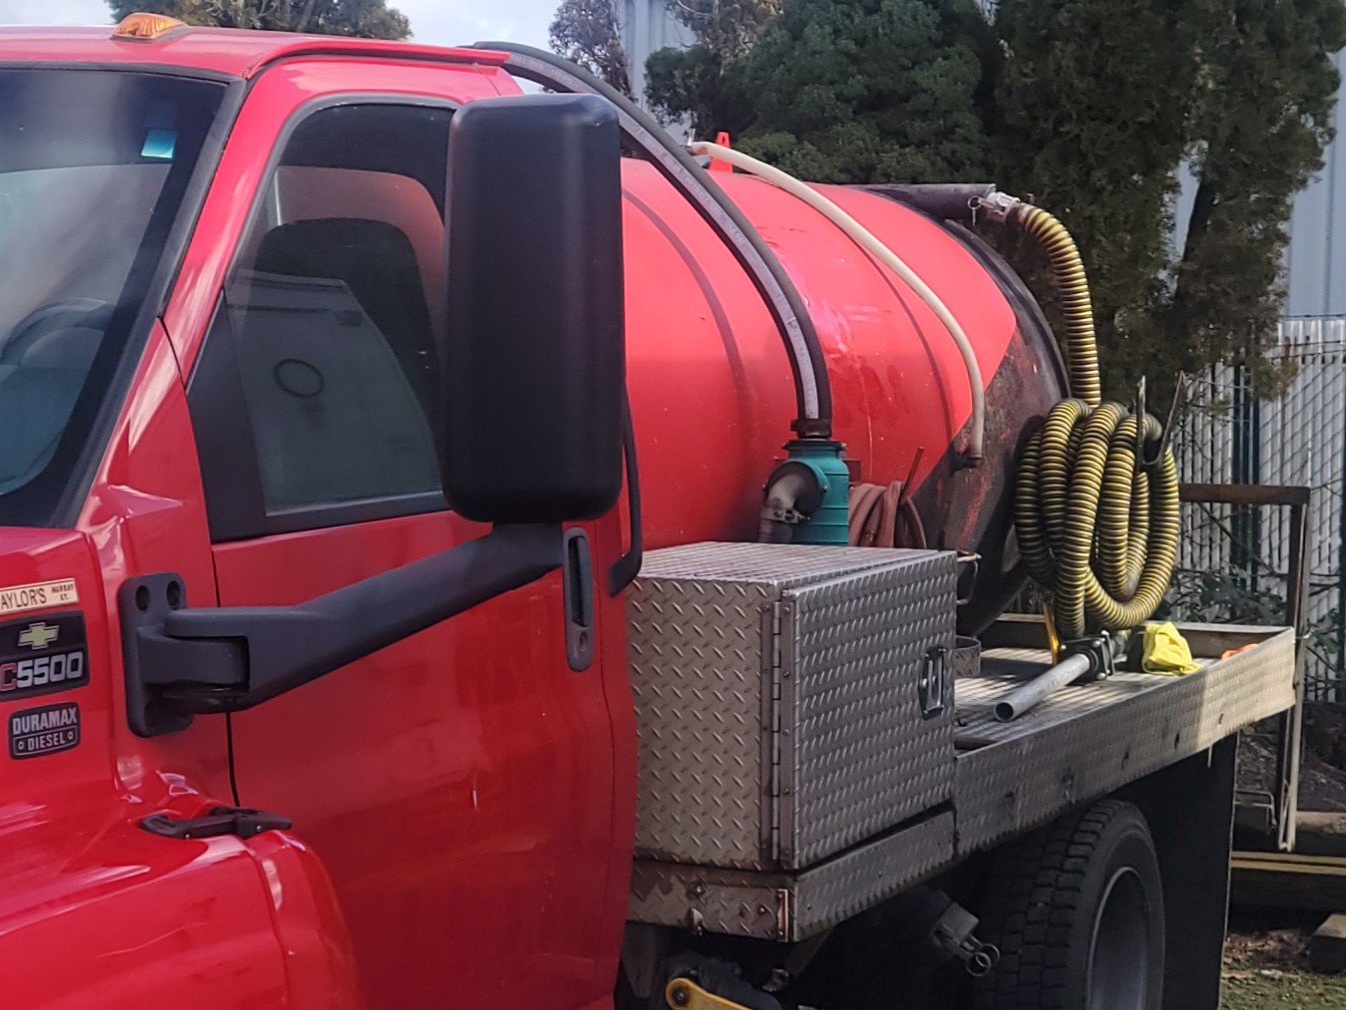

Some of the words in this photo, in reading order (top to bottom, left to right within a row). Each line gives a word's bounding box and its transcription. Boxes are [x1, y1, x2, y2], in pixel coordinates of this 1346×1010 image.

[0, 651, 83, 691] C5500
[12, 707, 78, 735] DURAMAX
[28, 731, 66, 751] DIESEL
